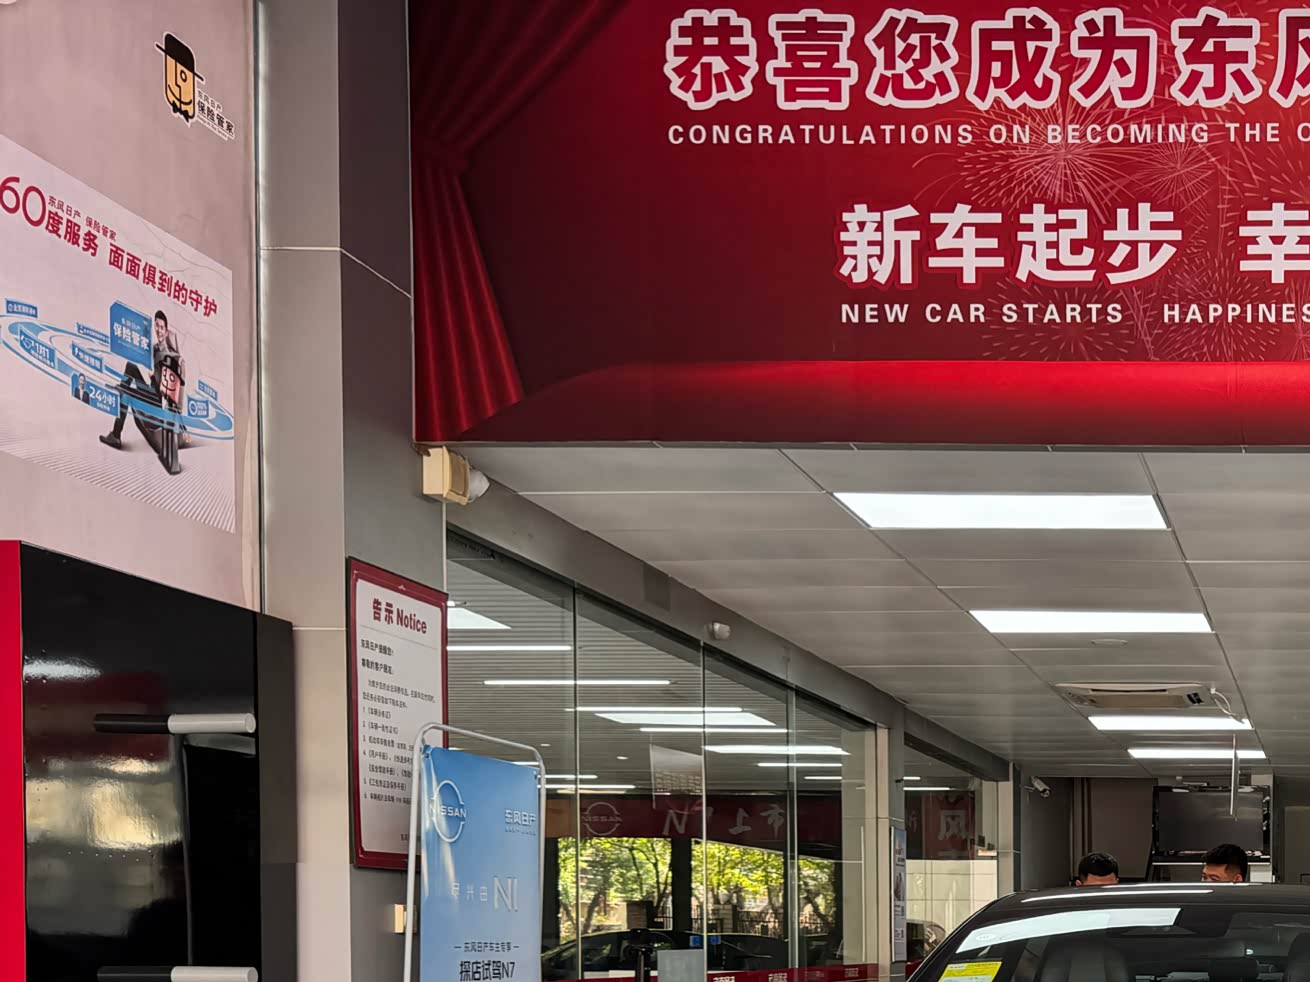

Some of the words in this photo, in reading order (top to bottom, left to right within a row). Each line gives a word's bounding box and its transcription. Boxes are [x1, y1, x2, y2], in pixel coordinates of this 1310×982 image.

[198, 100, 234, 135] 保险管家
[668, 124, 973, 145] CONGRATULATIONS
[990, 124, 1030, 144] ON
[1047, 123, 1210, 144] BECOMING
[1225, 122, 1280, 143] THE
[48, 195, 81, 219] 东风日产
[85, 215, 117, 242] 保险管家
[839, 204, 1182, 285] 新车起步
[108, 243, 217, 317] 面面俱到的守护
[841, 304, 909, 323] NEW
[925, 304, 986, 323] CAR
[1002, 304, 1122, 323] STARTS
[113, 322, 150, 350] 保险管家
[373, 598, 394, 624] 告示
[397, 608, 427, 634] Notice
[430, 804, 466, 818] NISSAN
[460, 960, 515, 981] 探店试驾N7
